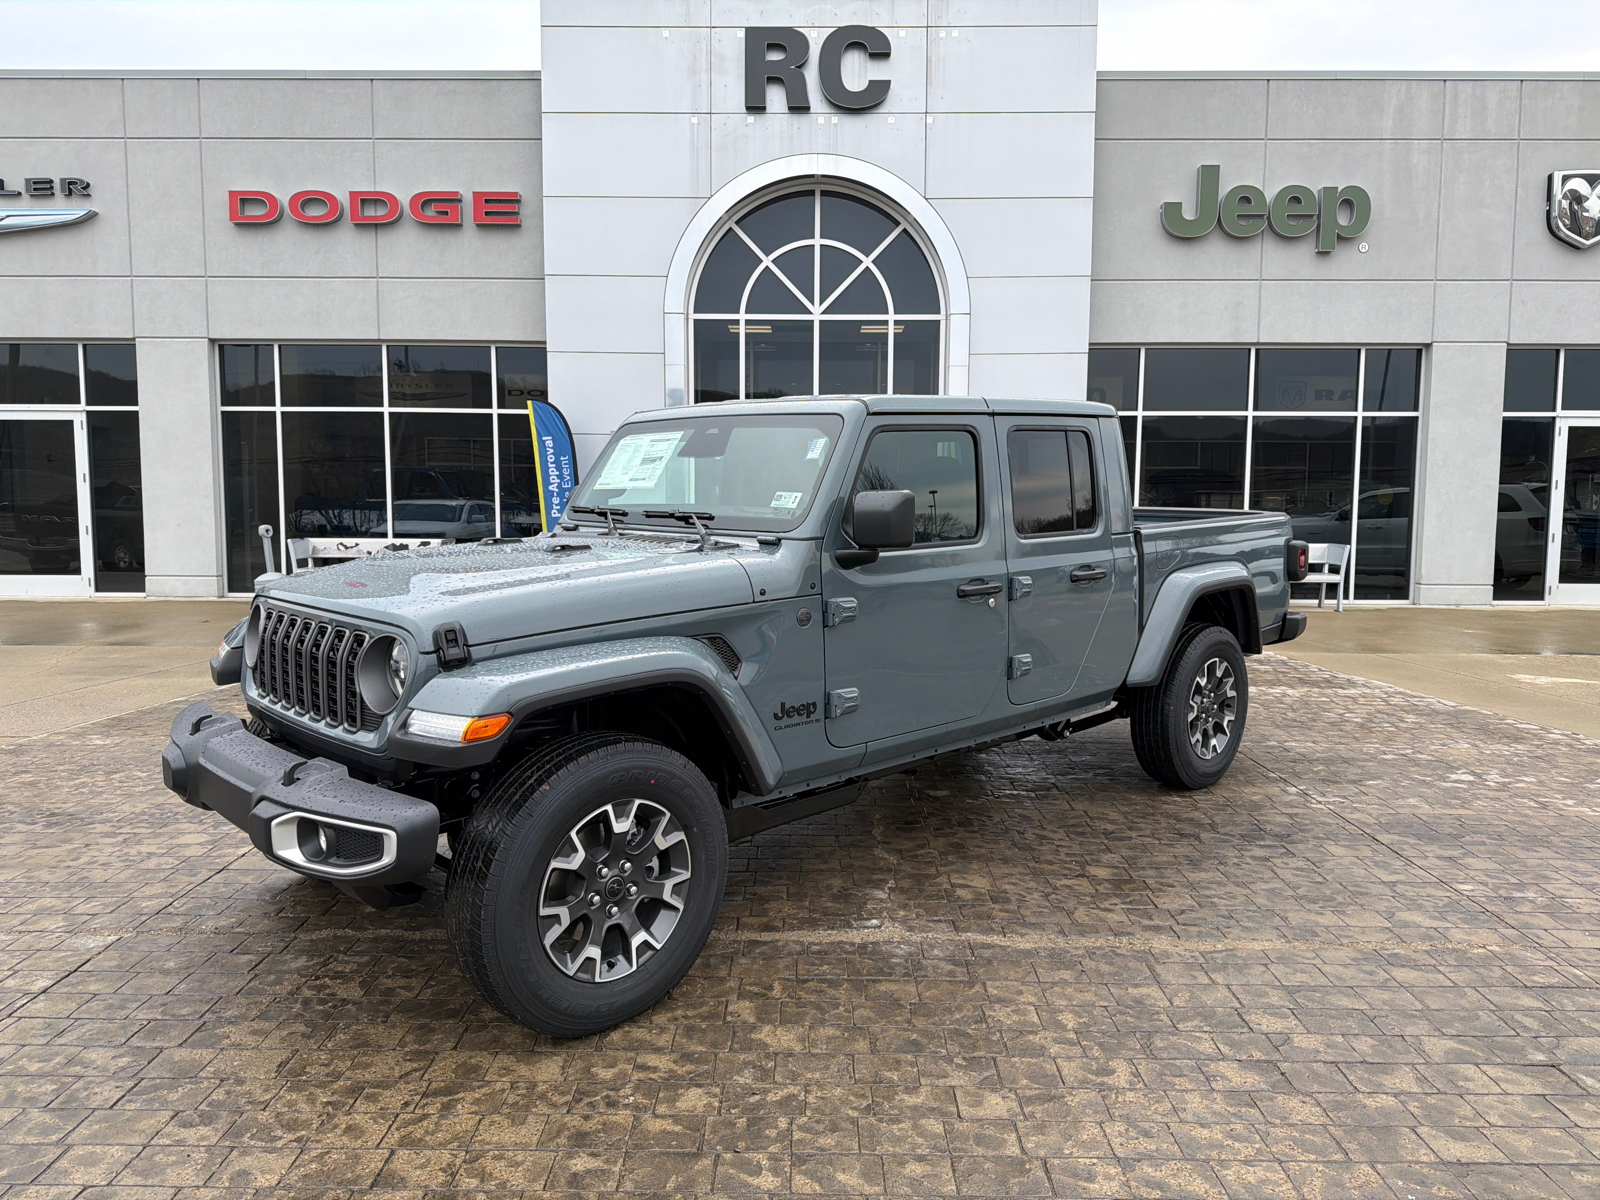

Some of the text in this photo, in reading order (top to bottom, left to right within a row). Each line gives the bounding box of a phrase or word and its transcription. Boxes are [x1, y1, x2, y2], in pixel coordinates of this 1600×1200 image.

[744, 25, 892, 111] RC
[228, 190, 522, 226] DODGE
[1160, 164, 1372, 254] Jeep
[541, 436, 561, 518] Pre-Approval
[560, 455, 572, 488] Event
[773, 701, 818, 720] Jeep
[774, 719, 815, 731] GLADIATOR
